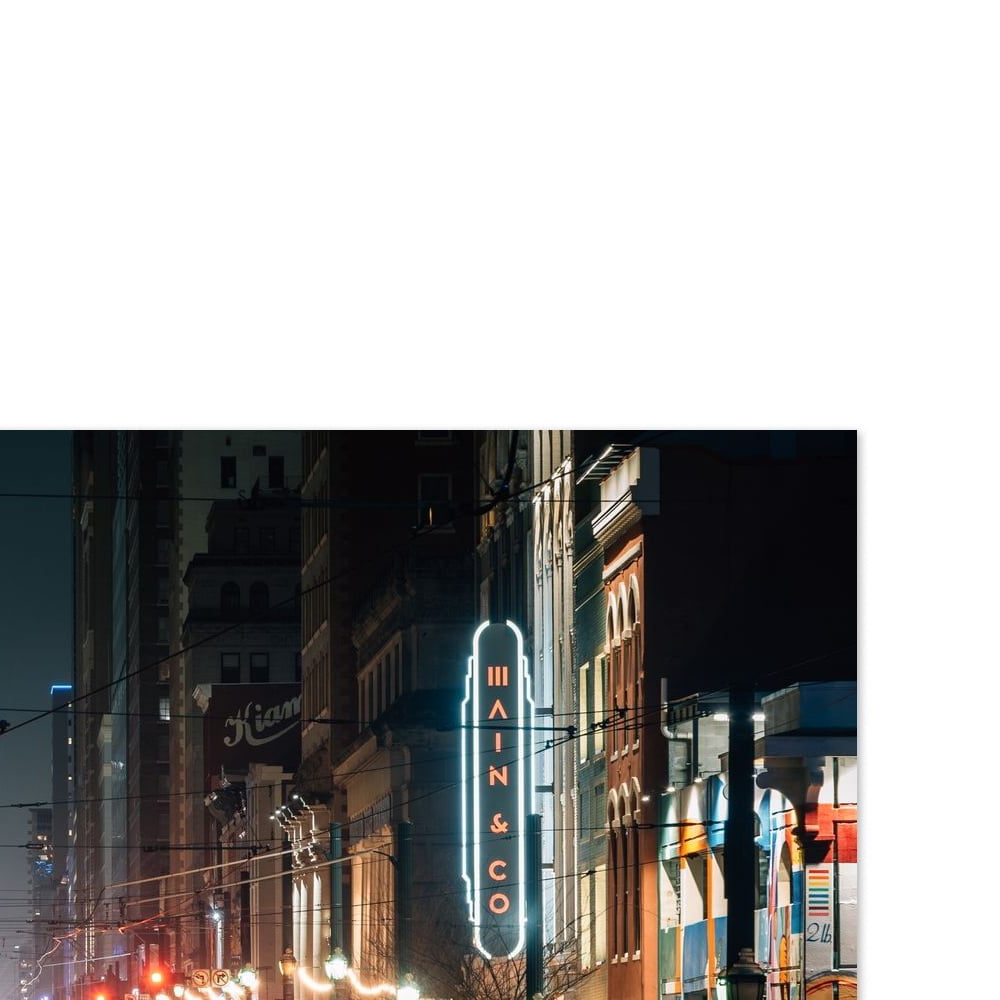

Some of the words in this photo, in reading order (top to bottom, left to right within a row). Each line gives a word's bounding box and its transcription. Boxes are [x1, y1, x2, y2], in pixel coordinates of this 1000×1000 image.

[487, 666, 509, 786] MAIN
[490, 813, 509, 834] &
[488, 860, 510, 914] CO
